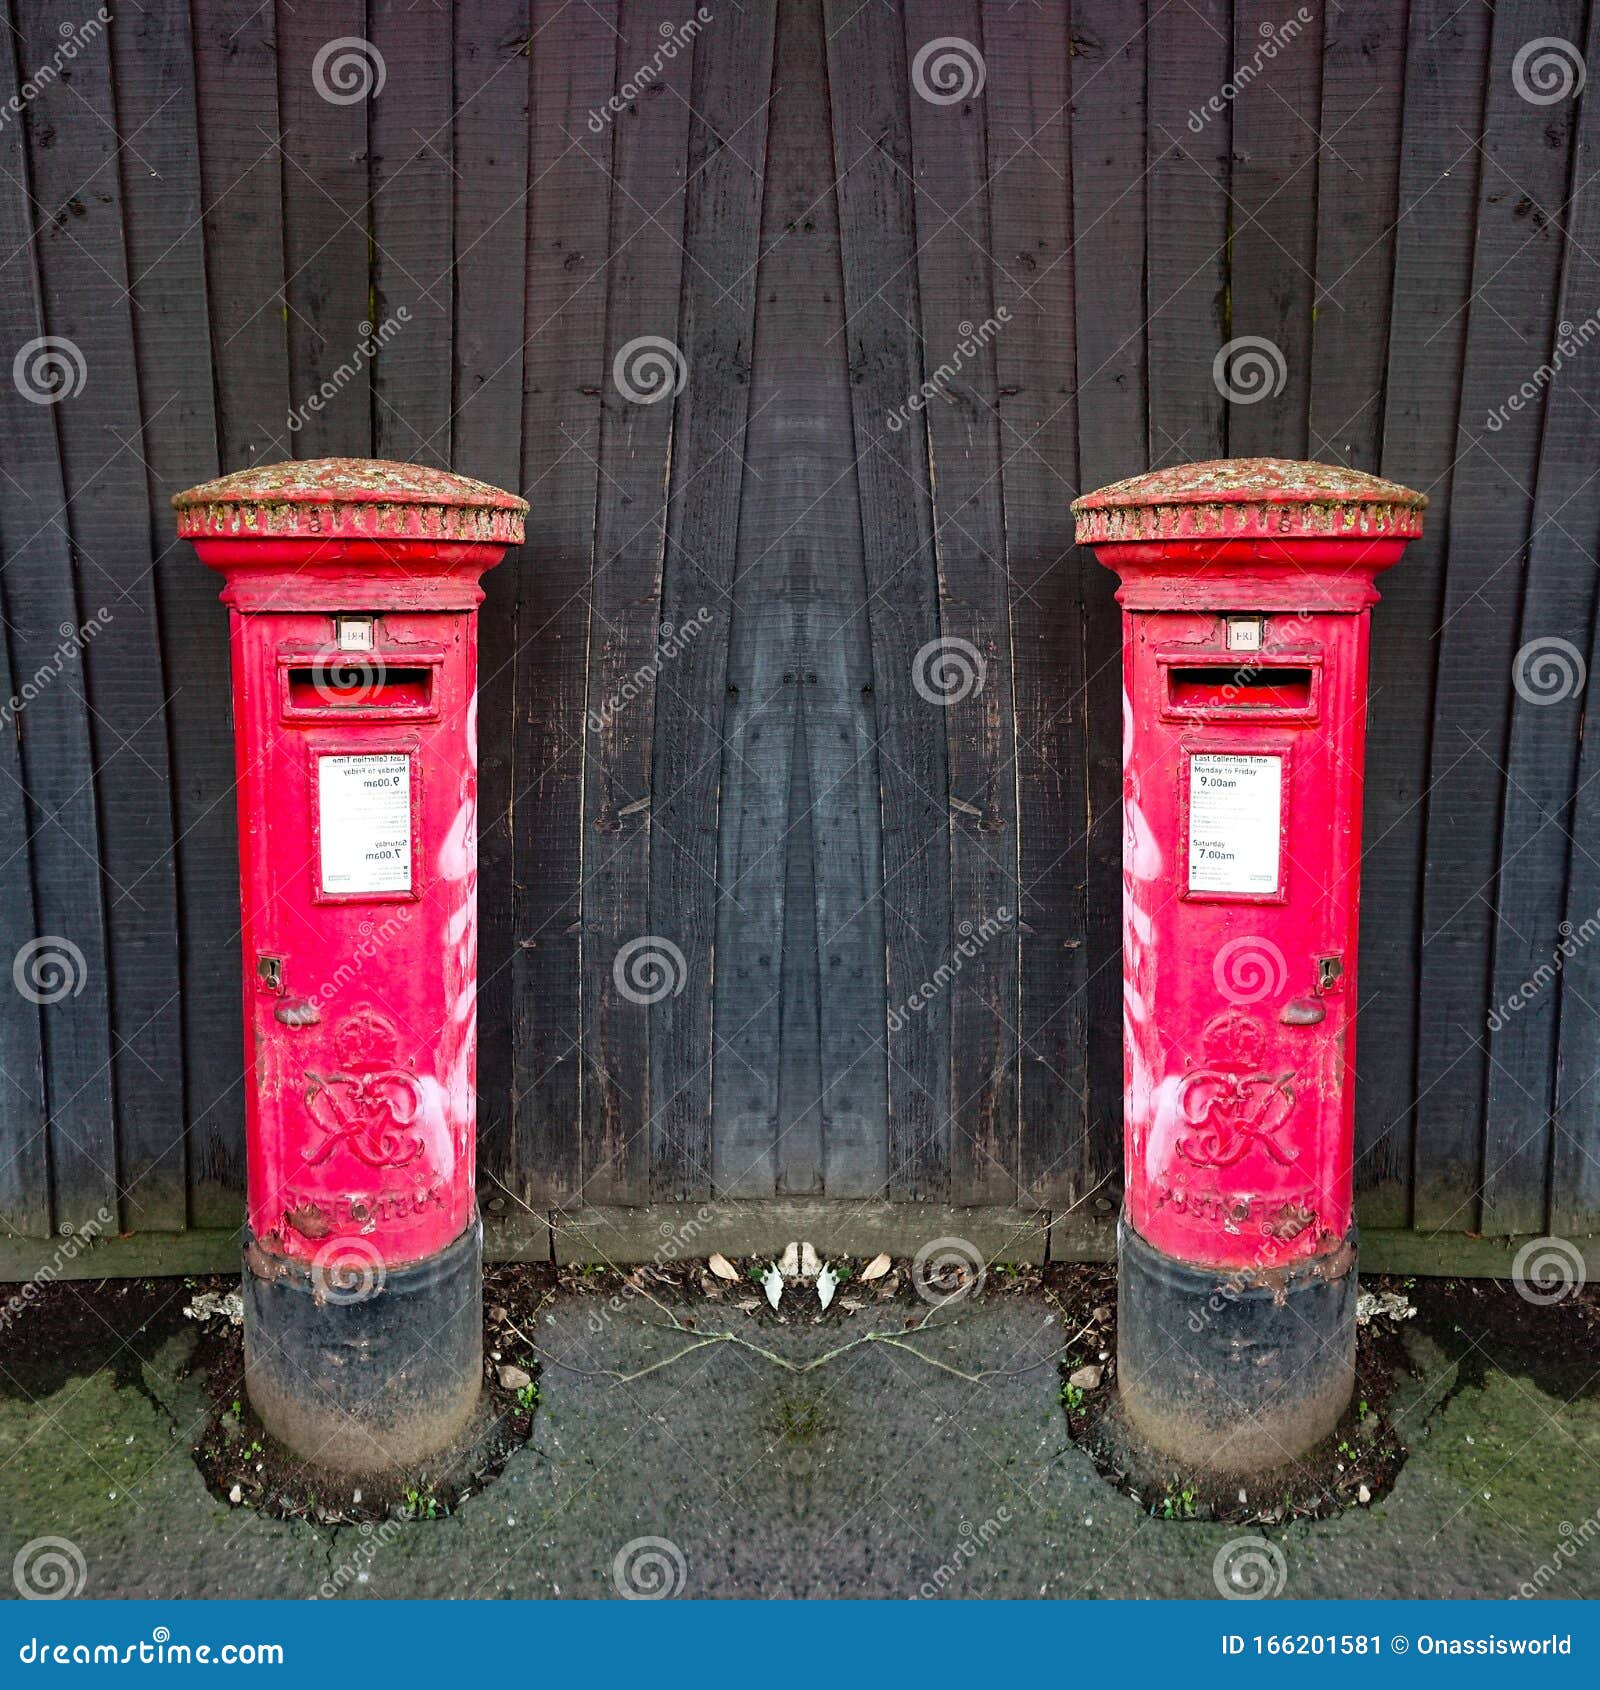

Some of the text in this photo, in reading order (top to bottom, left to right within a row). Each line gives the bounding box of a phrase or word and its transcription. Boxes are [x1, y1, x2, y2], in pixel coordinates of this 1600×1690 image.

[1194, 754, 1210, 762] Last
[1250, 756, 1268, 764] Time
[1194, 766, 1222, 775] Monday
[1234, 768, 1257, 776] Friday
[1200, 776, 1237, 788] 9.00am
[1193, 839, 1225, 848] Saturday
[1199, 848, 1235, 861] 7.00am
